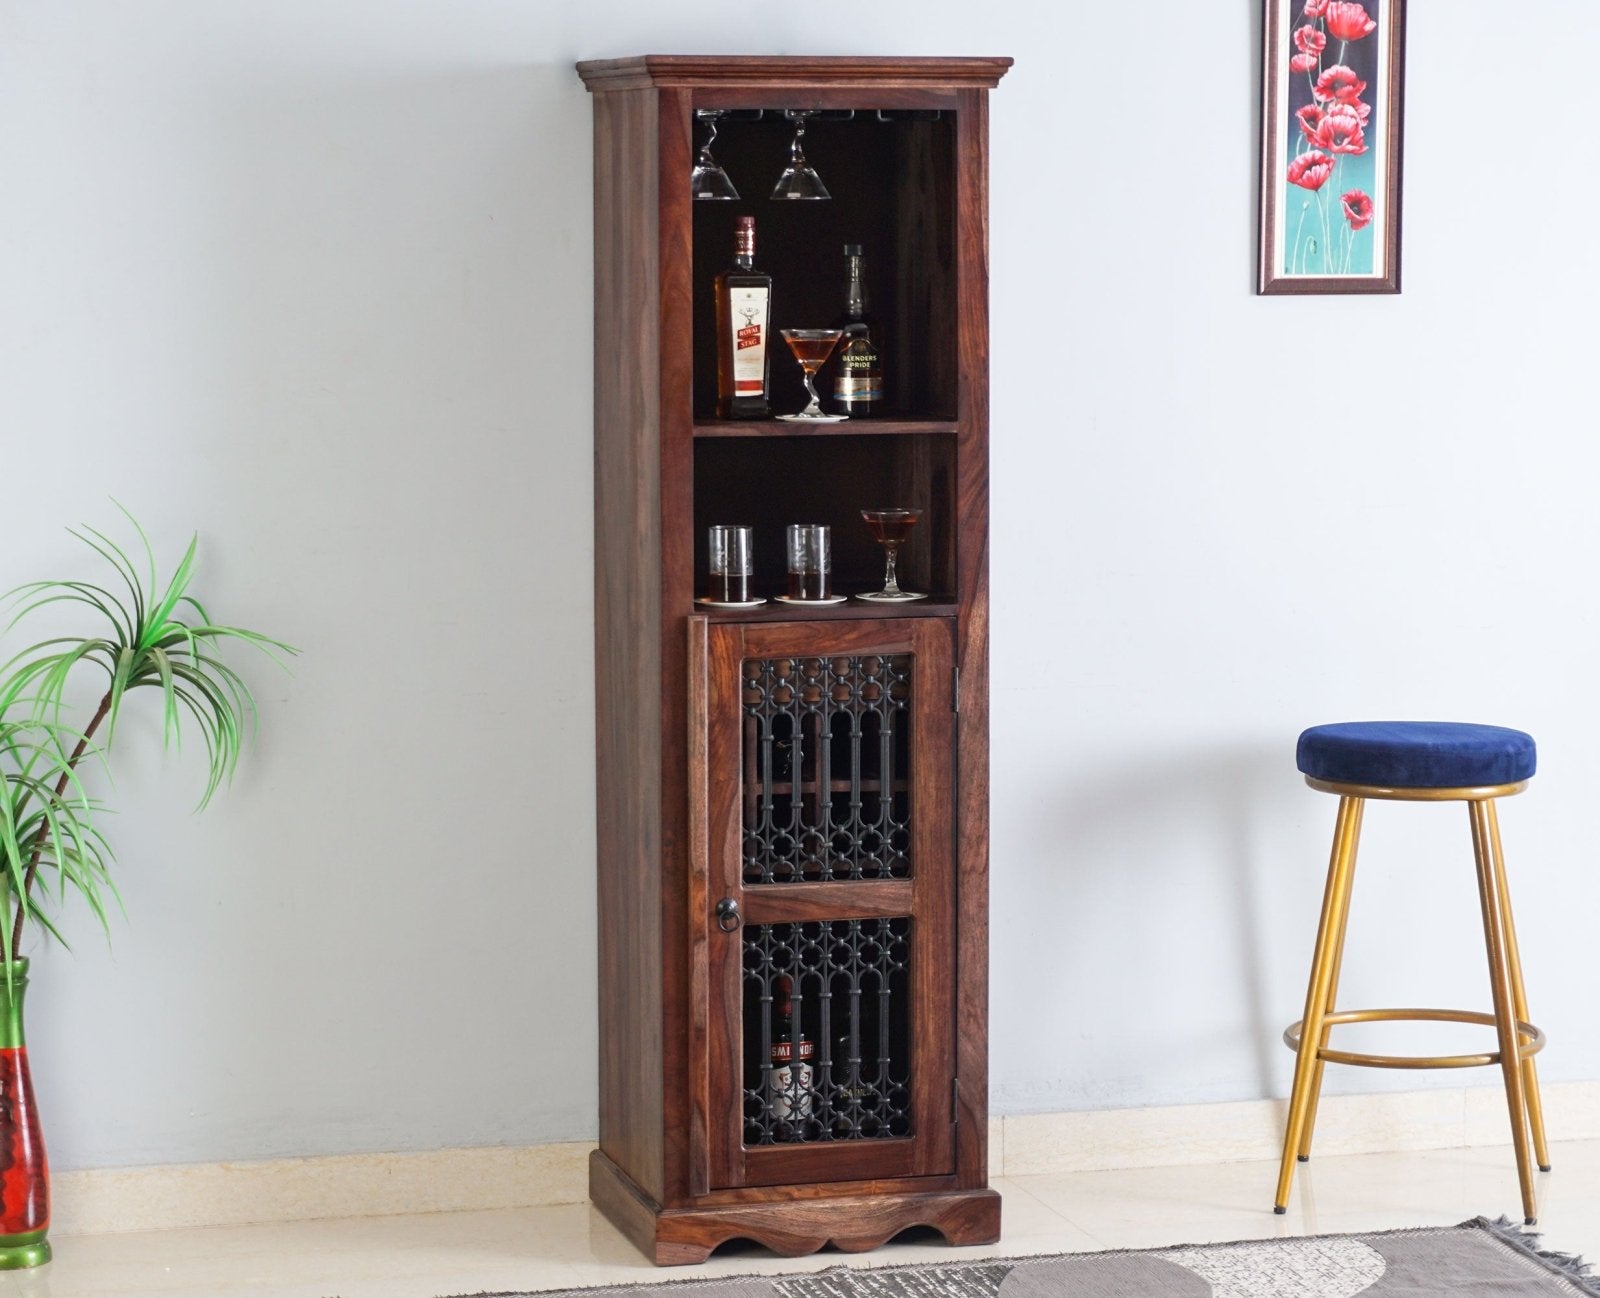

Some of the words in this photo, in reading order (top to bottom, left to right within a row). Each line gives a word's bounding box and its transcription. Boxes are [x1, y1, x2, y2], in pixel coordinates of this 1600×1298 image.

[739, 326, 759, 337] ROYAL
[741, 338, 757, 347] STAG
[842, 354, 877, 362] BLENDERS
